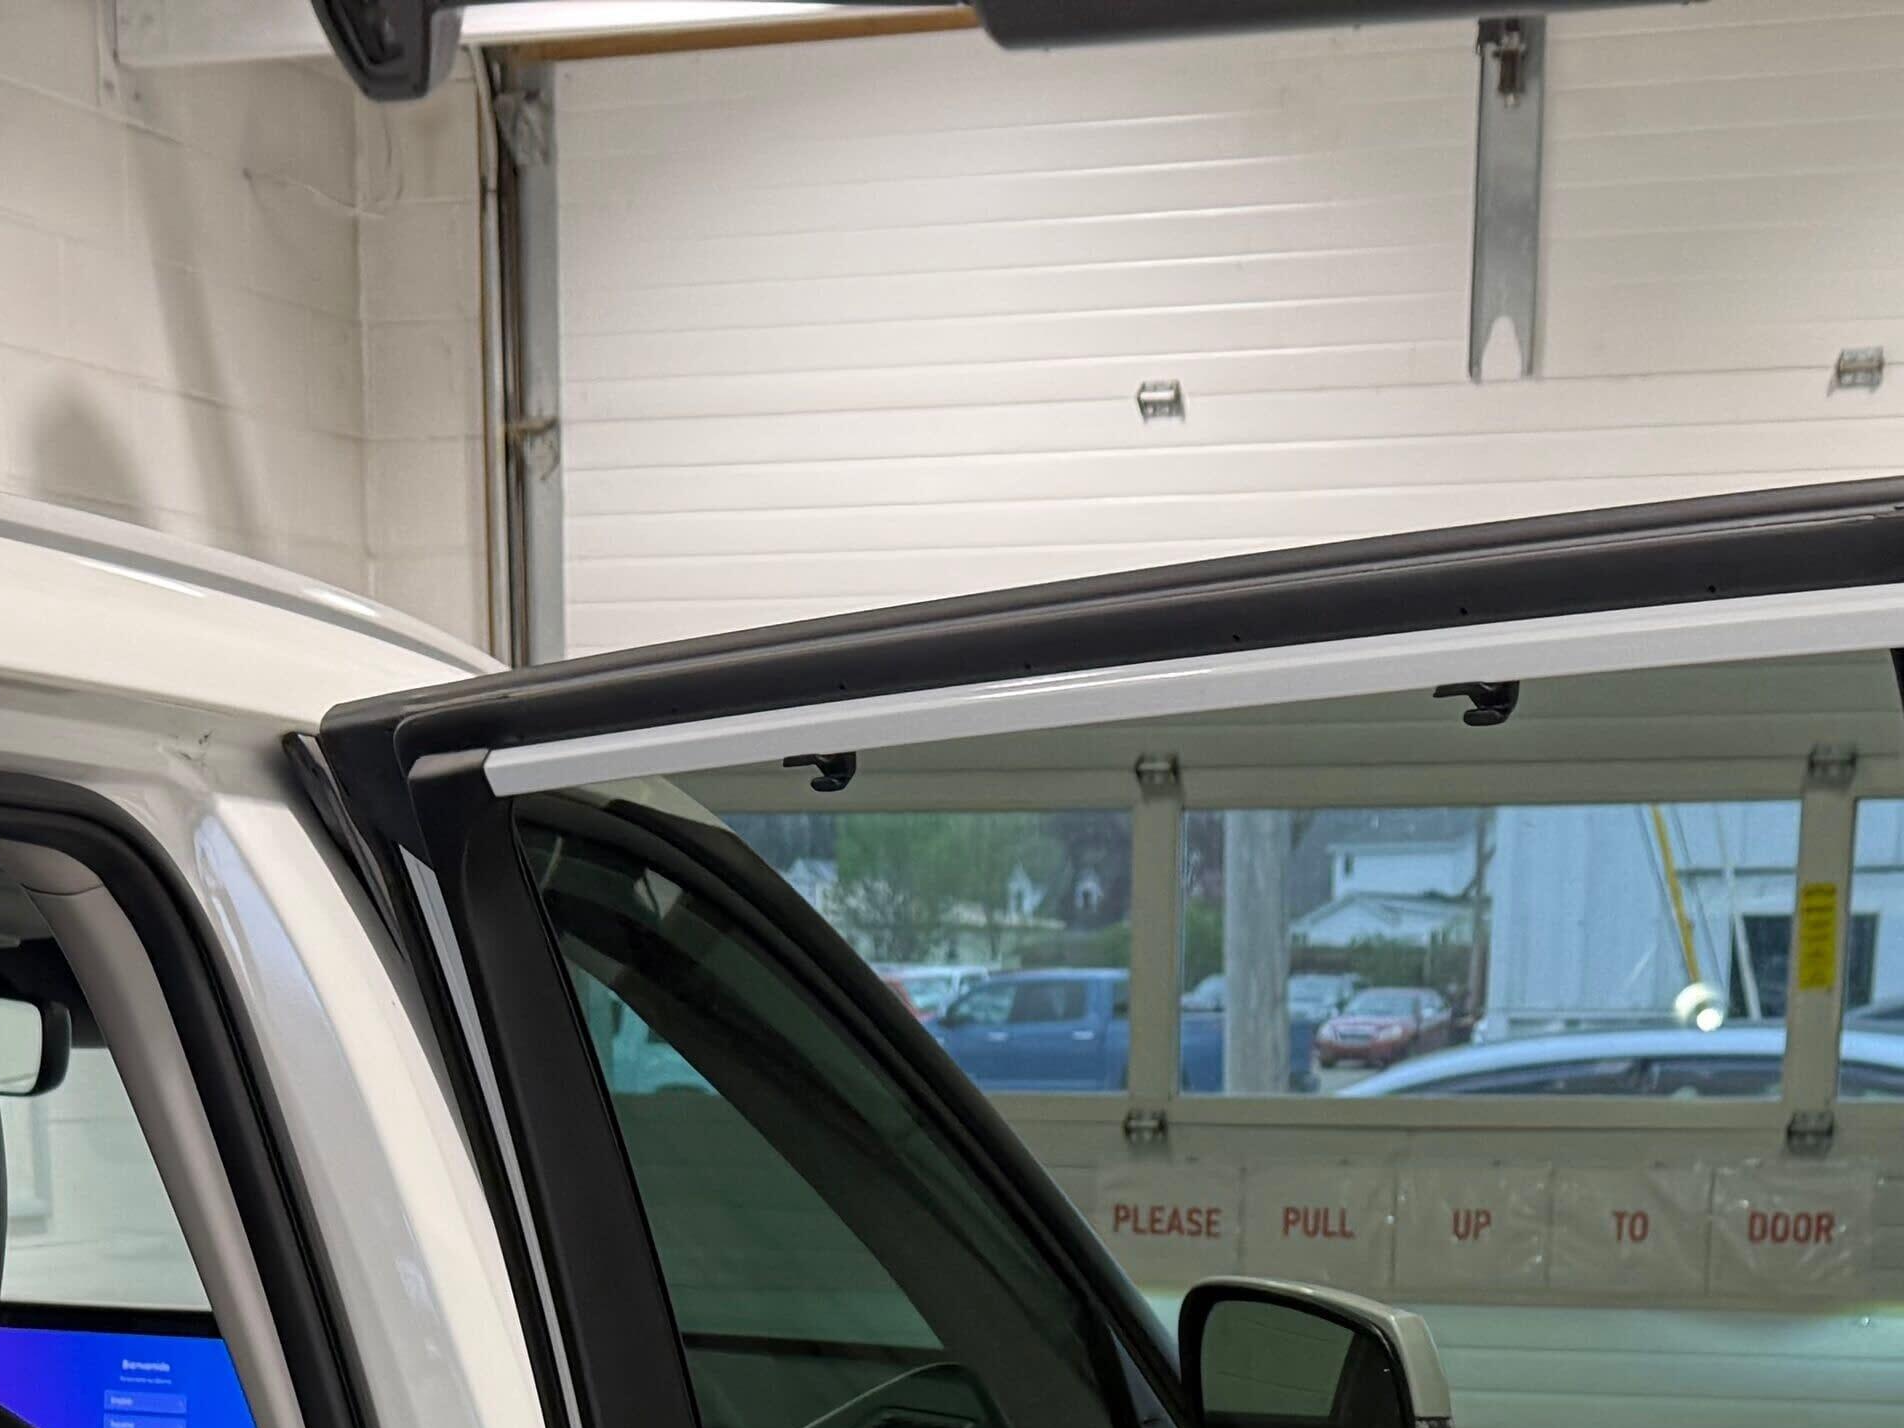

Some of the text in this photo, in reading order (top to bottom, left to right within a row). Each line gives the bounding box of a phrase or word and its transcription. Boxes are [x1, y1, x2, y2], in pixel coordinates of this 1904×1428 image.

[1112, 1203, 1836, 1245] PLEASE PULL UP TO DOOR
